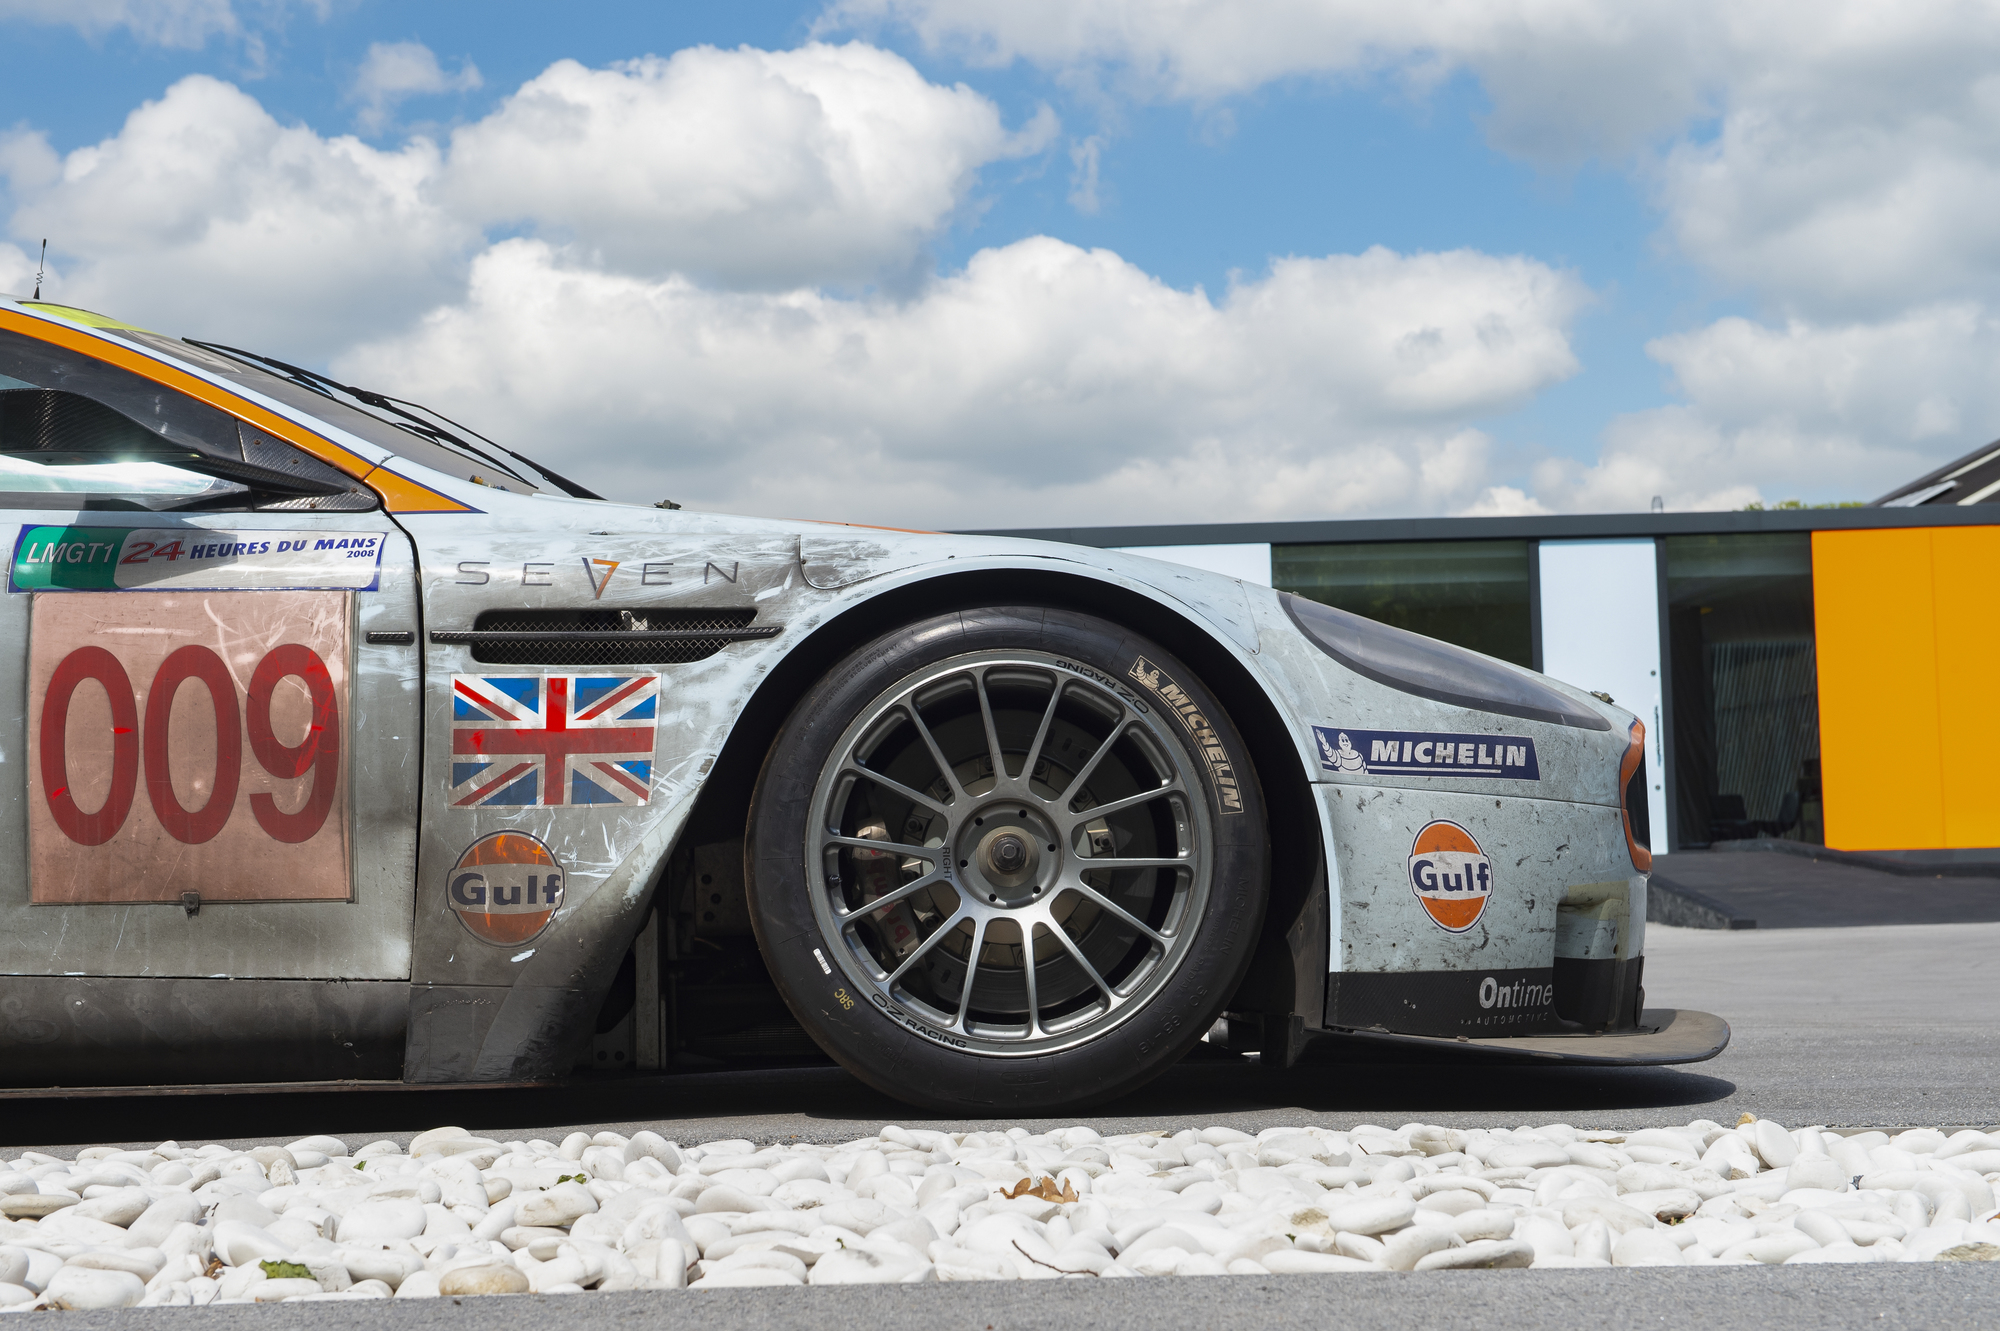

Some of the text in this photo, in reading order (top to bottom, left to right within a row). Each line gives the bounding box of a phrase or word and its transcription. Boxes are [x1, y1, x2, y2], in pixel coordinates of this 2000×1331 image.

[26, 542, 114, 564] LMGT1
[119, 537, 376, 565] 24 HEURES DU MANS
[346, 549, 375, 559] 2008
[455, 557, 740, 600] SEVEN
[836, 660, 862, 684] PURPOSE
[863, 647, 880, 660] ONLY
[1056, 660, 1116, 689] RACING
[40, 643, 340, 846] 009
[1160, 683, 1240, 809] MICHELIN
[1370, 739, 1527, 767] MICHELIN
[942, 846, 952, 880] RIGHT
[1412, 860, 1489, 893] Gulf
[451, 872, 561, 905] Gulf
[1218, 876, 1250, 956] MICHELIN
[1173, 955, 1205, 996] RADIAL
[1479, 976, 1553, 1009] Ontime
[905, 1019, 967, 1048] RACING
[1476, 1012, 1548, 1026] AUTOMOTIVE
